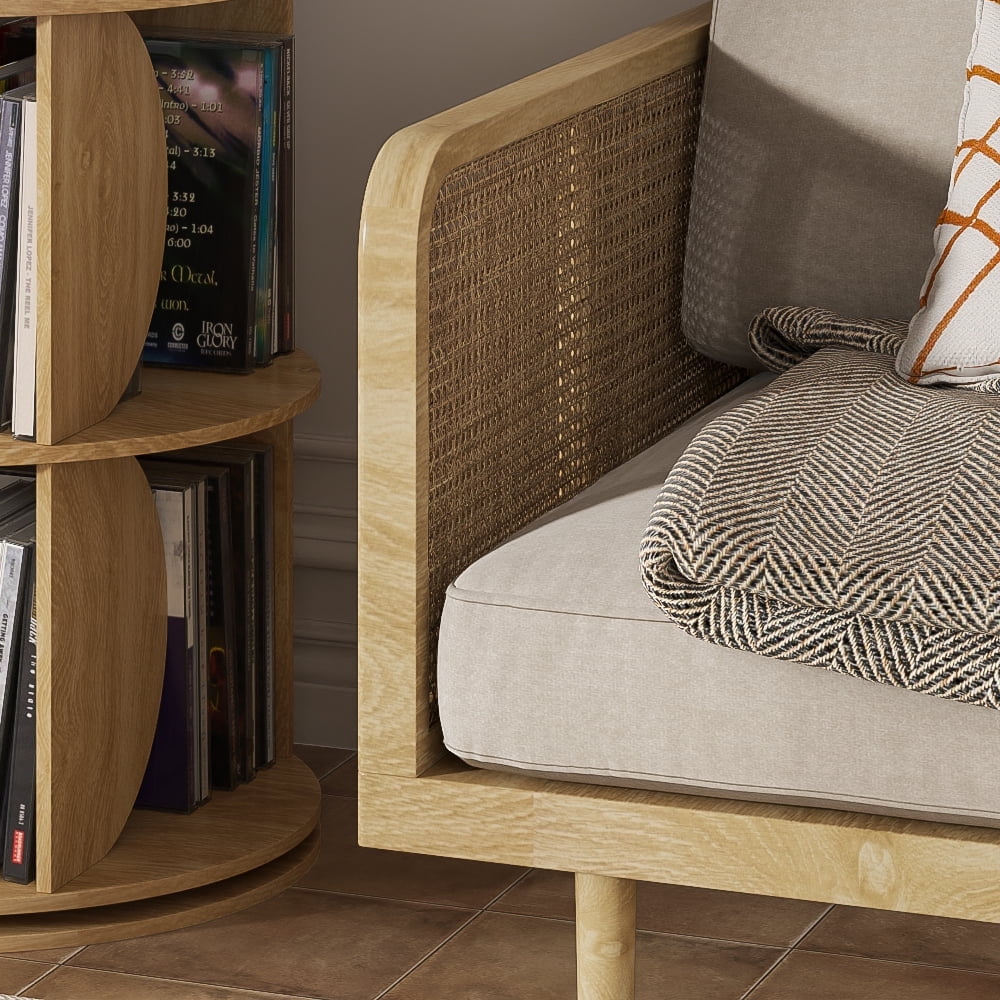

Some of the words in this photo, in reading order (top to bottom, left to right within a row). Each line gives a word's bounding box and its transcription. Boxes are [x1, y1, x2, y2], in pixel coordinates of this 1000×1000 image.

[167, 86, 190, 95] 4:41
[200, 102, 223, 113] 1:01
[165, 115, 180, 125] :03
[193, 147, 216, 158] 3:13
[2, 149, 14, 185] JENNIFER
[0, 185, 10, 208] LOPEZ
[172, 192, 195, 202] 3:32
[167, 208, 187, 217] :20
[191, 223, 214, 234] 1:04
[167, 238, 191, 248] 6:00
[24, 317, 31, 329] ME
[202, 320, 233, 336] IRON
[197, 331, 237, 349] GLORY
[0, 613, 9, 642] GETTING
